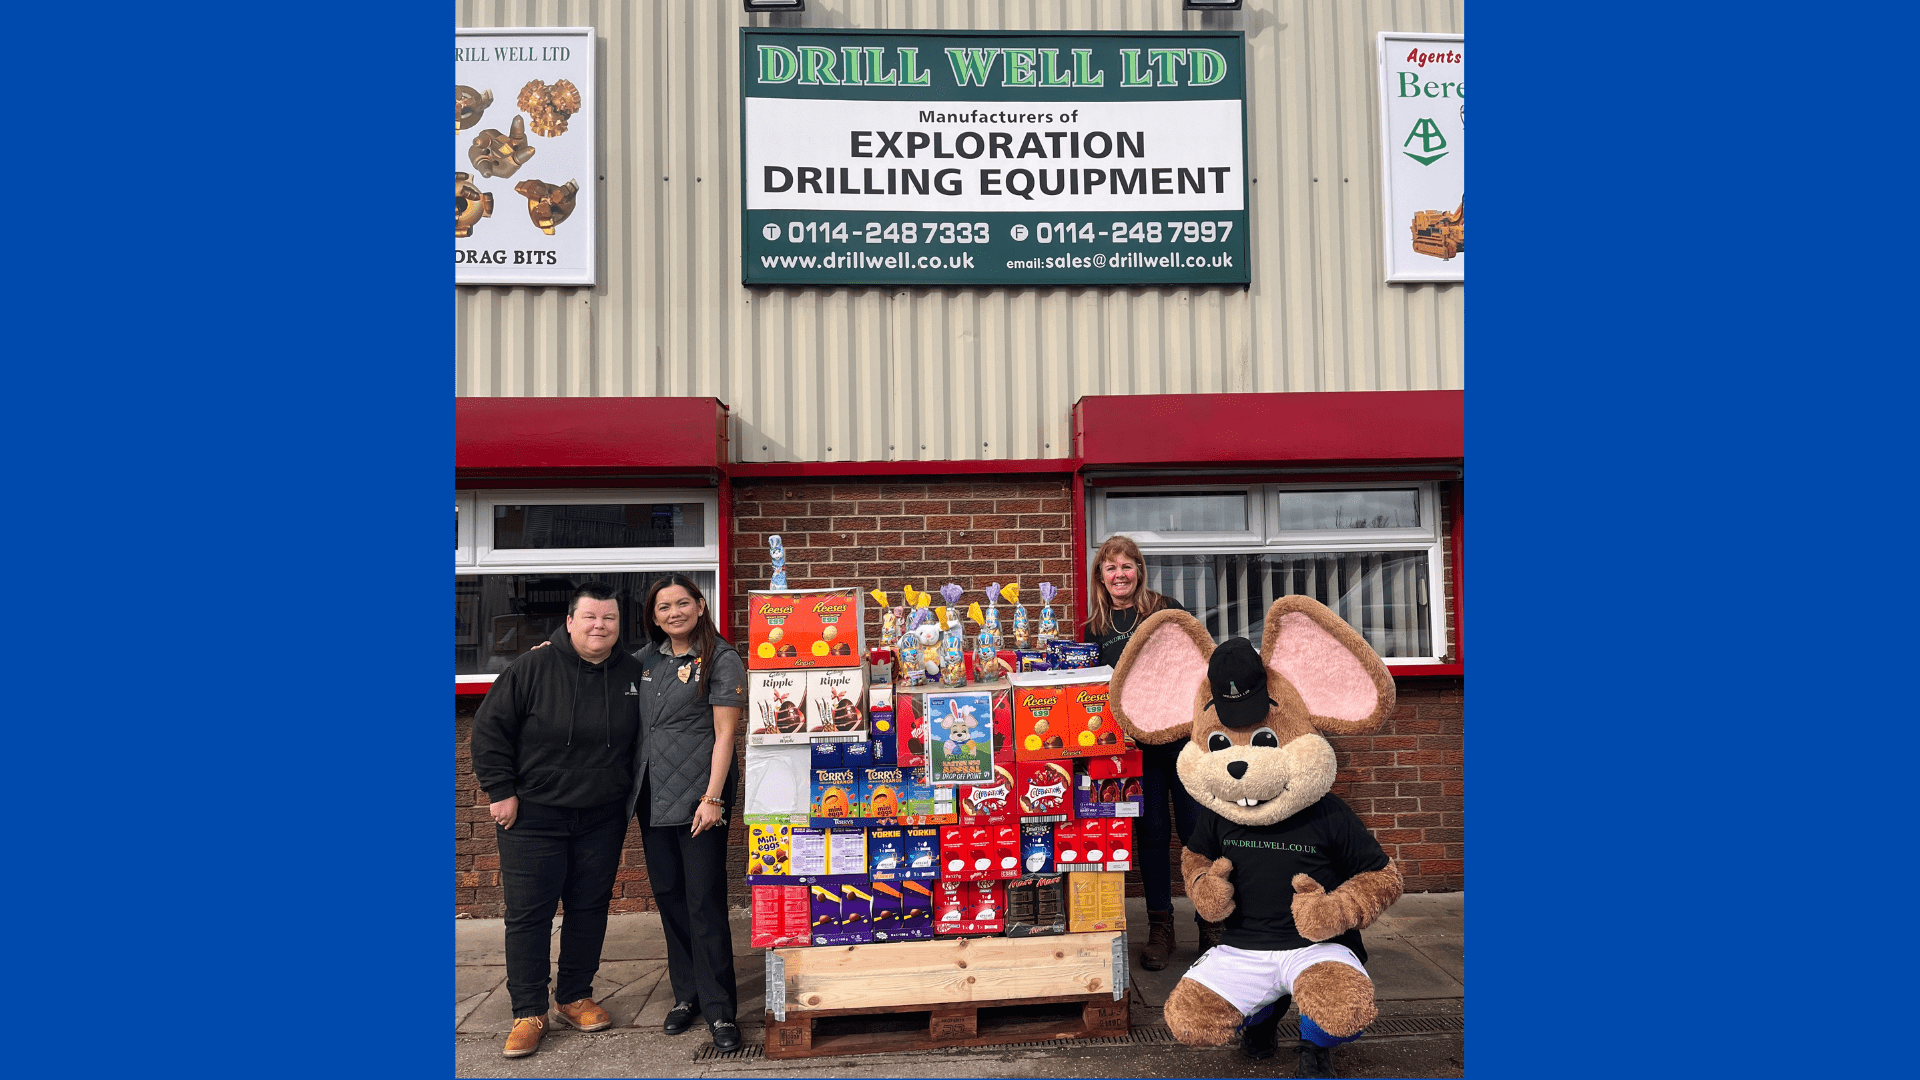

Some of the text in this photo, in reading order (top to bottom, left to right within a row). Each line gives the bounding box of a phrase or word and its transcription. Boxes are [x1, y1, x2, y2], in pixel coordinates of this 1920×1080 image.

[495, 46, 537, 61] WELL
[542, 46, 570, 61] LTD
[1407, 48, 1461, 67] Agents
[757, 45, 1227, 87] DRILL WELL LTD
[919, 109, 1078, 124] Manufacturers of
[851, 131, 1145, 159] EXPLORATION
[764, 165, 1230, 200] DRILLING EQUIPMENT
[922, 222, 990, 244] 7333
[1167, 221, 1233, 243] 7997
[455, 250, 557, 265] DRAG BITS
[761, 252, 975, 269] www.drillwell.co.uk
[763, 678, 793, 688] Ripple
[820, 676, 850, 687] Ripple
[1022, 694, 1057, 707] Reese's
[757, 834, 777, 845] Mini
[872, 831, 901, 839] YORKIE
[758, 841, 780, 852] eggs
[1008, 879, 1033, 889] Mars
[1036, 877, 1061, 887] Mars
